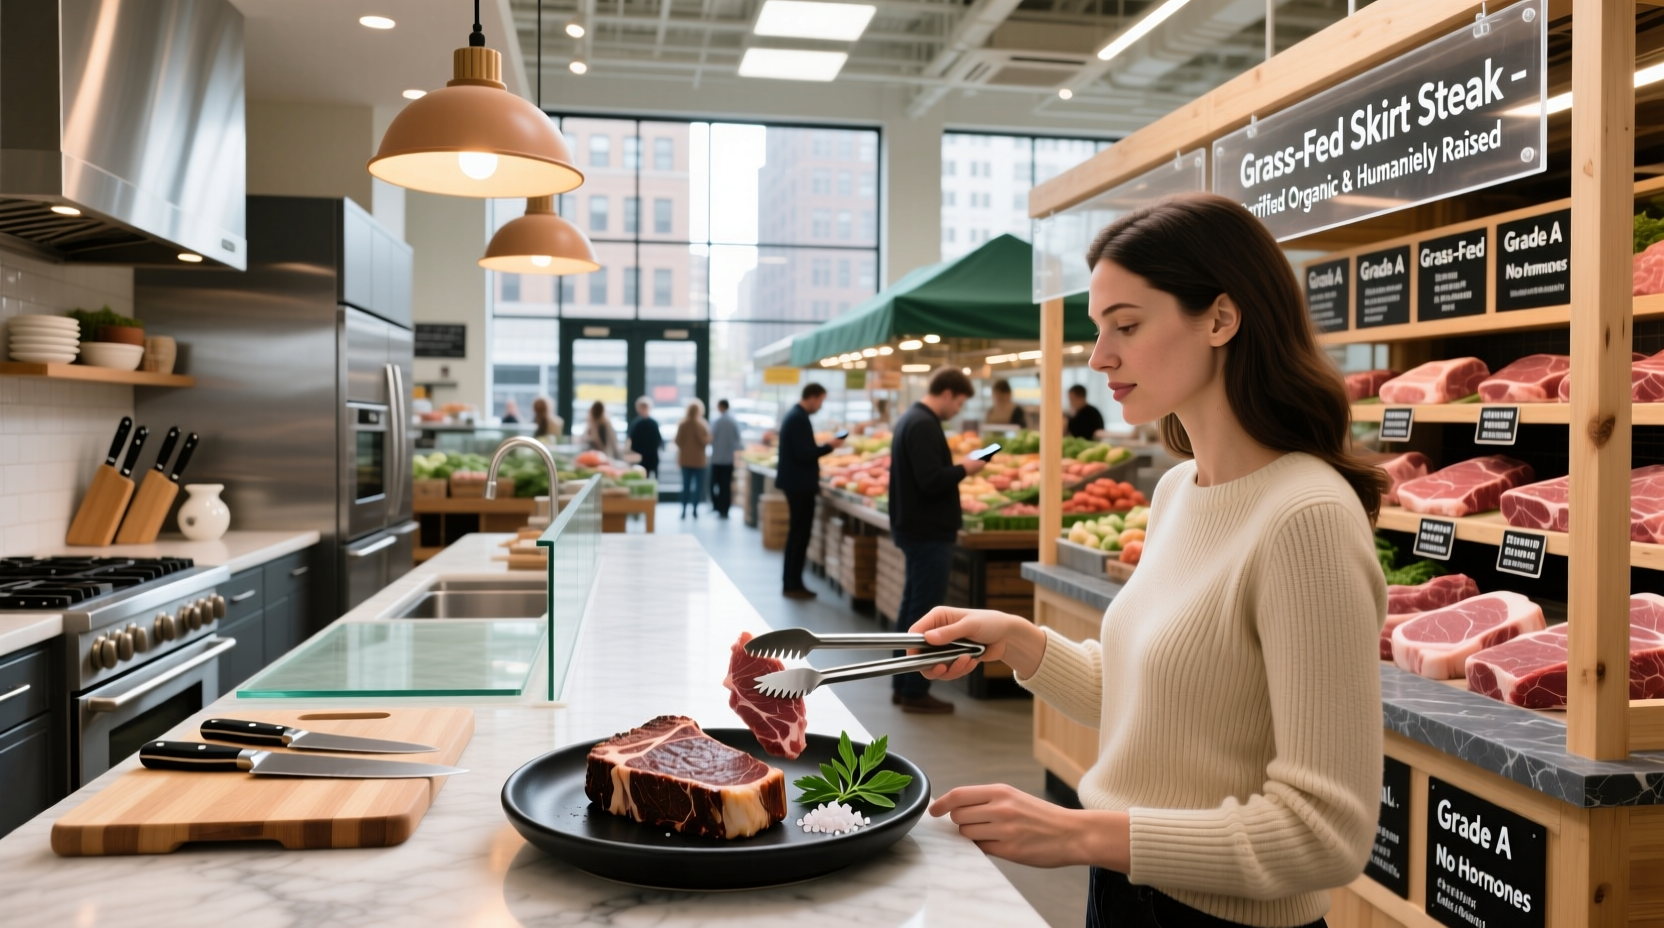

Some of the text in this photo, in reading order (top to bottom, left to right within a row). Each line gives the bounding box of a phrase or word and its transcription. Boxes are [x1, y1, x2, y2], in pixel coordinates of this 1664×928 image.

[1240, 58, 1527, 188] Grass-Fed Skirt Steak -
[1288, 174, 1339, 213] Organic
[1342, 169, 1353, 193] &
[1357, 143, 1438, 187] Humaniely
[1442, 119, 1501, 162] Raised
[1394, 254, 1405, 274] A
[1504, 221, 1562, 252] Grade A
[1505, 263, 1522, 280] No
[1437, 799, 1512, 860] Grade A
[1436, 843, 1455, 873] No
[1458, 856, 1531, 913] Hormones
